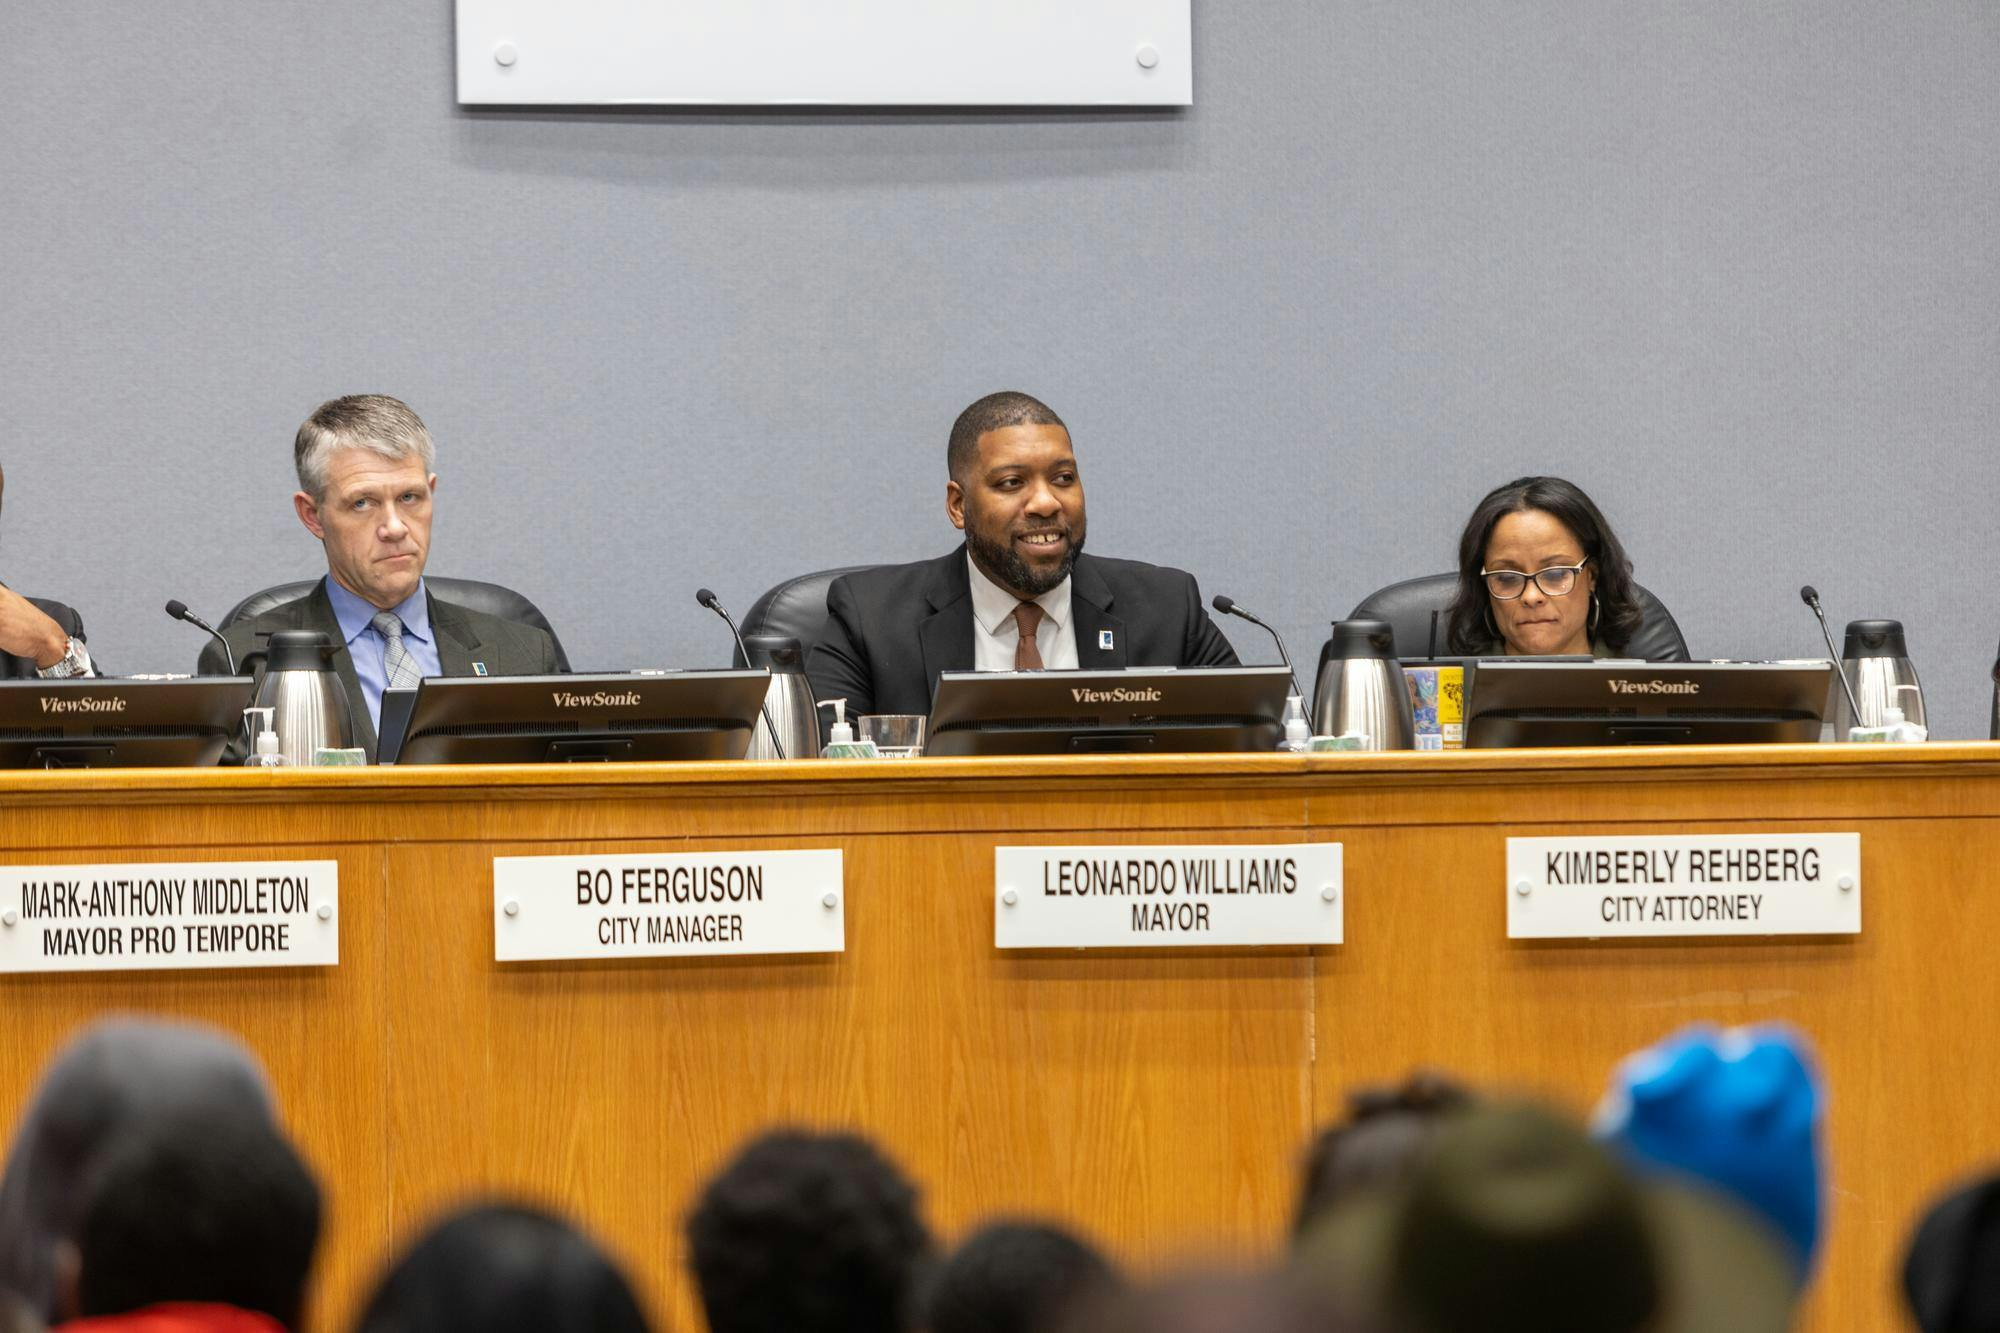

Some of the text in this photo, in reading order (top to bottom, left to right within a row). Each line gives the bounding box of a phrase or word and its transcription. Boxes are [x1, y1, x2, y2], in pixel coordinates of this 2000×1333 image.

[552, 691, 642, 707] ViewSonic
[1071, 687, 1163, 703] ViewSonic
[1608, 679, 1700, 694] ViewSonic
[40, 696, 128, 713] ViewSonic
[1044, 858, 1298, 896] LEONARDO WILLIAMS
[1547, 847, 1820, 885] KIMBERLY REHBERG
[22, 877, 310, 919] MARK-ANTHONY MIDDLETON
[577, 865, 764, 905] BO FERGUSON
[1132, 902, 1210, 931] MAYOR
[1601, 895, 1763, 922] CITY ATTORNEY
[43, 924, 290, 956] MAYOR PRO TEMPORE
[598, 914, 743, 945] CITY MANAGER
